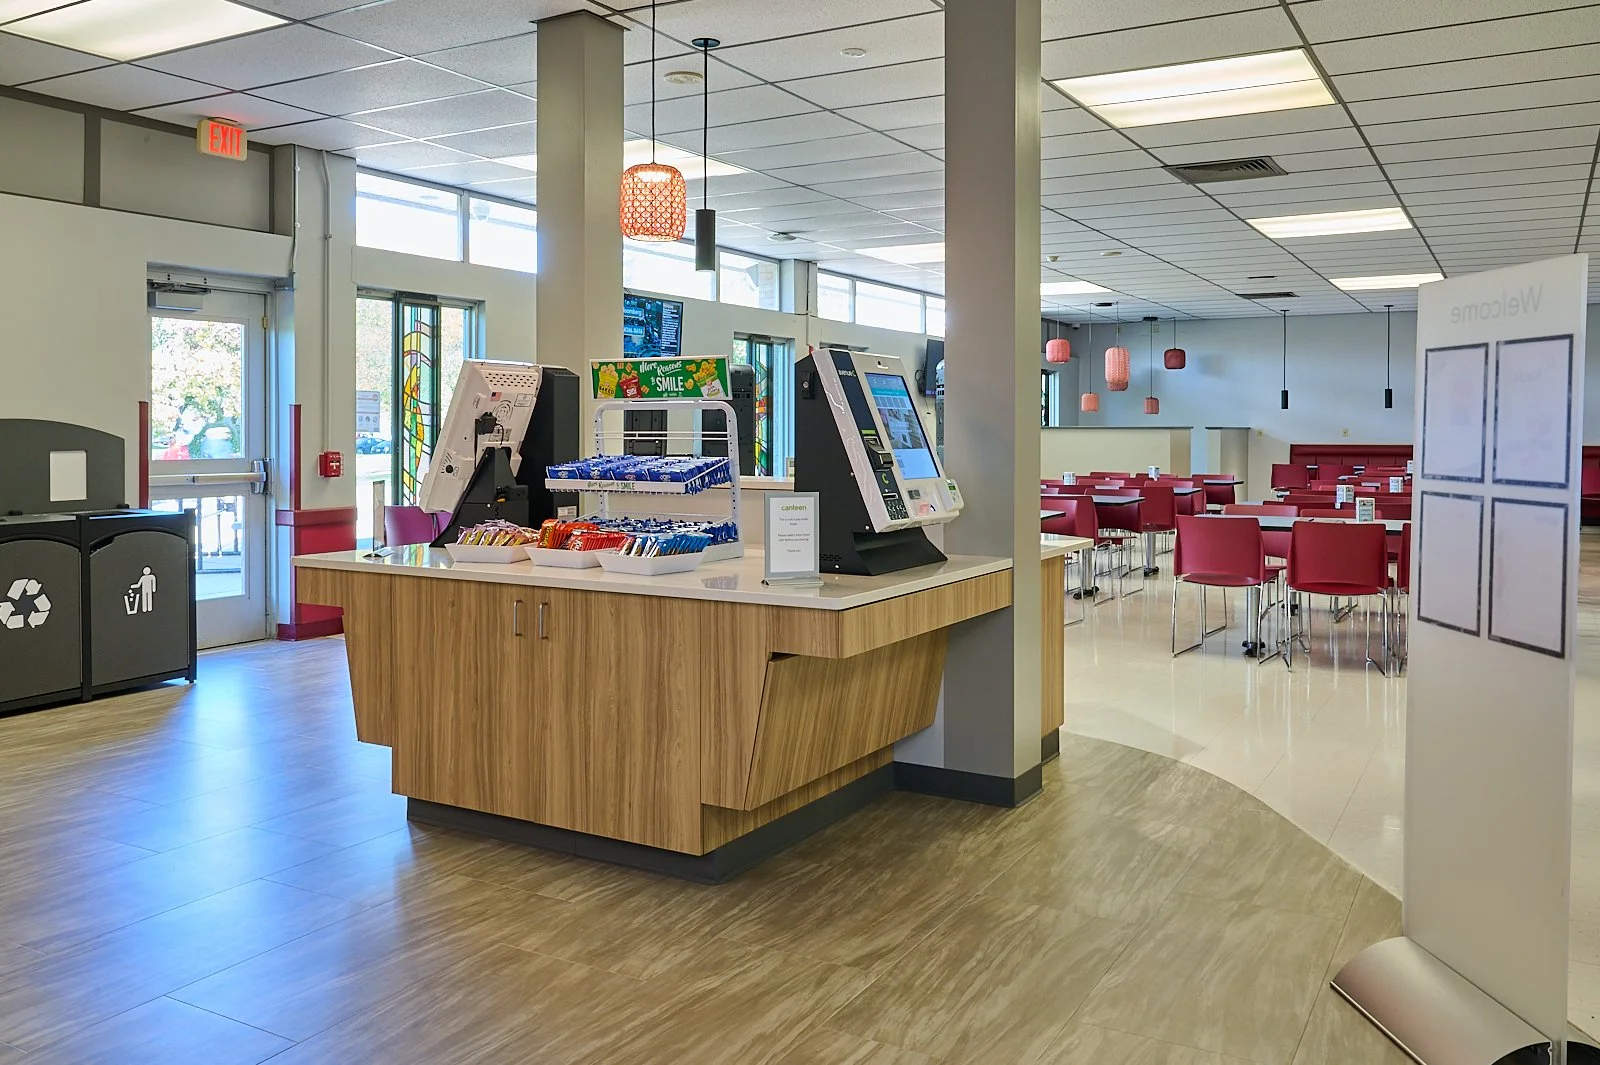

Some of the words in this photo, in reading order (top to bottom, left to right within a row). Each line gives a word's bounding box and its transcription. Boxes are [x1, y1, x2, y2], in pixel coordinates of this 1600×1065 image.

[209, 121, 243, 158] EXIT
[640, 361, 657, 373] More
[657, 361, 682, 376] Reasons
[599, 385, 615, 395] BAKED
[656, 377, 684, 391] SMILE
